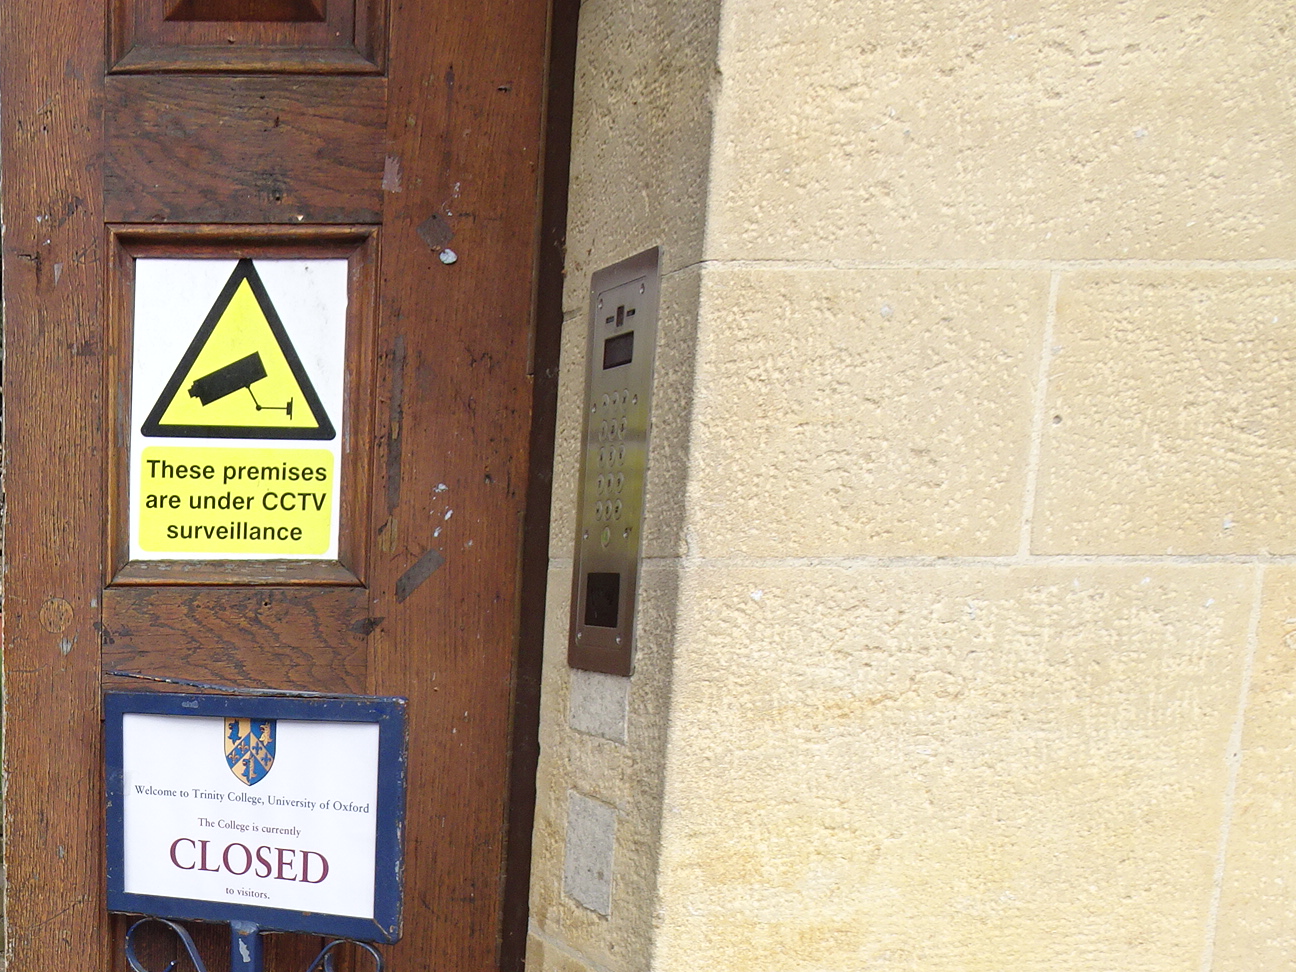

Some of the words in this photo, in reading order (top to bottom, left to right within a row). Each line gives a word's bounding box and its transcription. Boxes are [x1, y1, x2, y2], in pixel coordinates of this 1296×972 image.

[146, 459, 215, 479] These
[223, 462, 327, 484] premises
[145, 494, 181, 509] are
[189, 492, 254, 511] under
[262, 492, 327, 511] CCTV
[167, 522, 302, 540] surveillance
[135, 785, 176, 797] Welcome
[179, 788, 190, 799] to
[192, 789, 225, 803] Trinity
[227, 791, 265, 806] College,
[267, 795, 316, 811] University
[319, 800, 330, 812] of
[333, 800, 370, 814] Oxford
[198, 818, 216, 829] The
[217, 819, 250, 833] College
[252, 822, 259, 833] is
[261, 825, 301, 838] currently
[169, 837, 330, 884] CLOSED
[225, 887, 235, 896] to
[237, 888, 270, 900] visitors.
